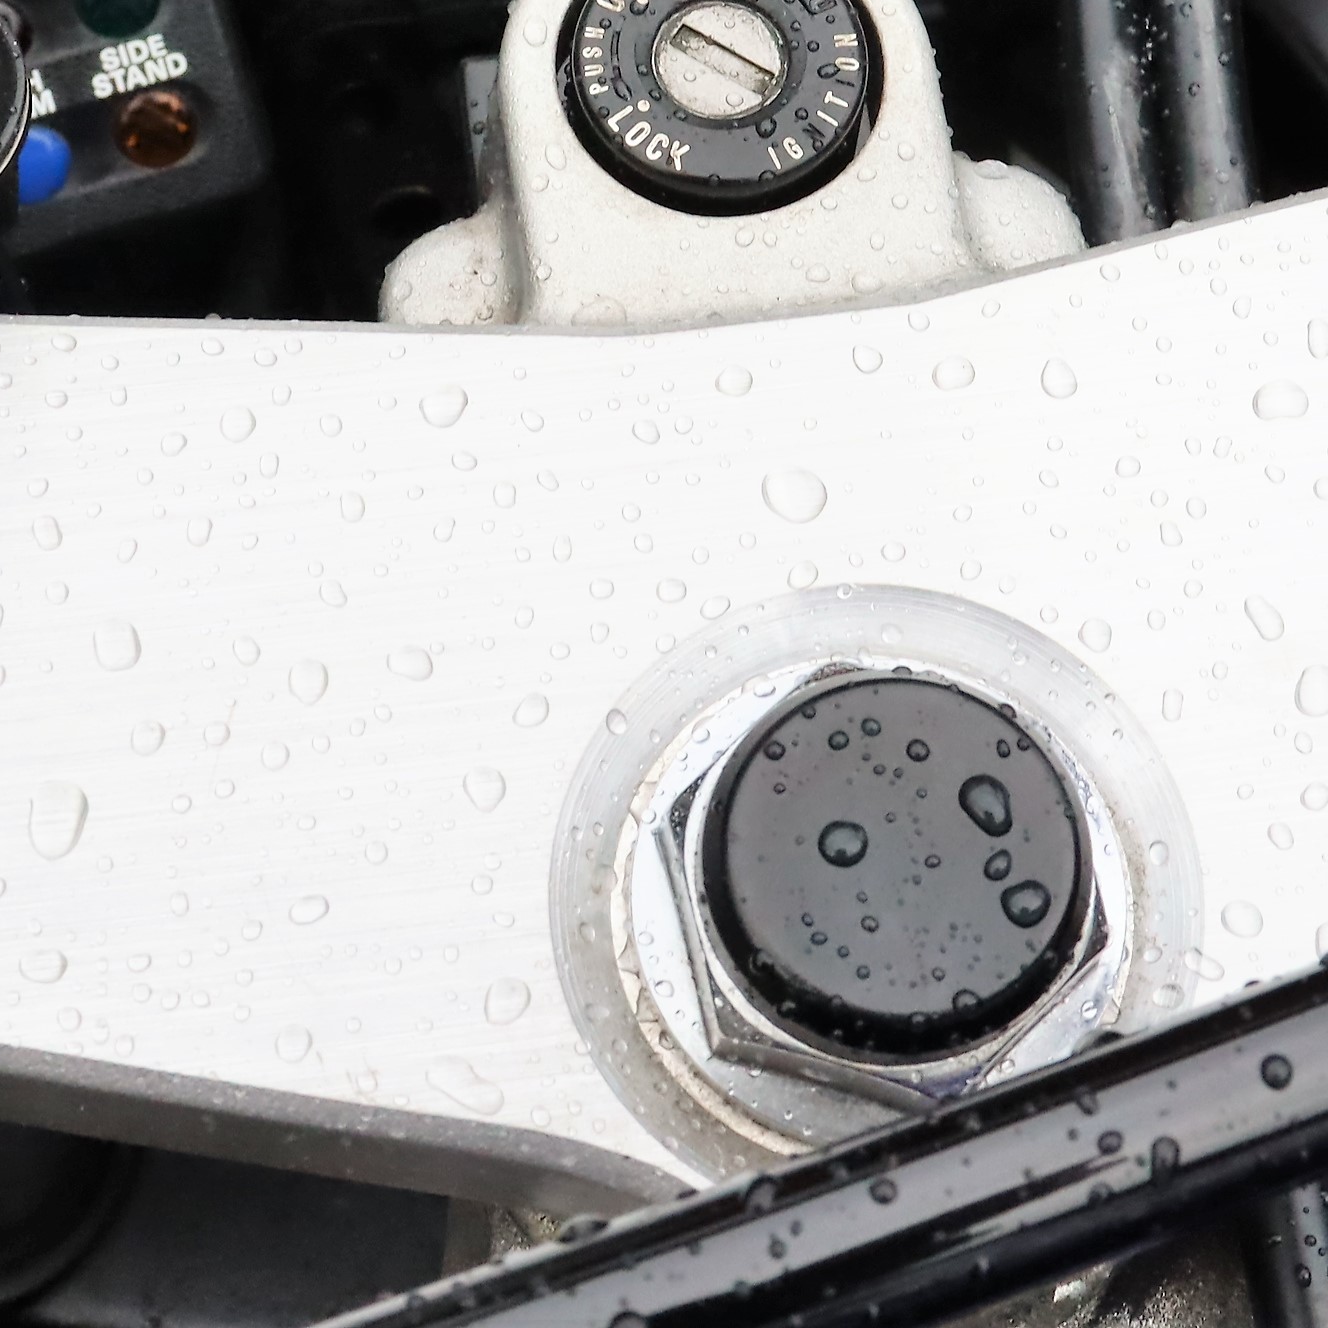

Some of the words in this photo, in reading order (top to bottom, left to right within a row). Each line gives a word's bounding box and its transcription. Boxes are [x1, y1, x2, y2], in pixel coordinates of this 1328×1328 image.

[90, 51, 189, 100] STAND
[99, 32, 170, 73] SIDE
[582, 26, 610, 96] PUSH
[766, 33, 861, 170] IGNITION
[607, 104, 691, 171] LOCK
